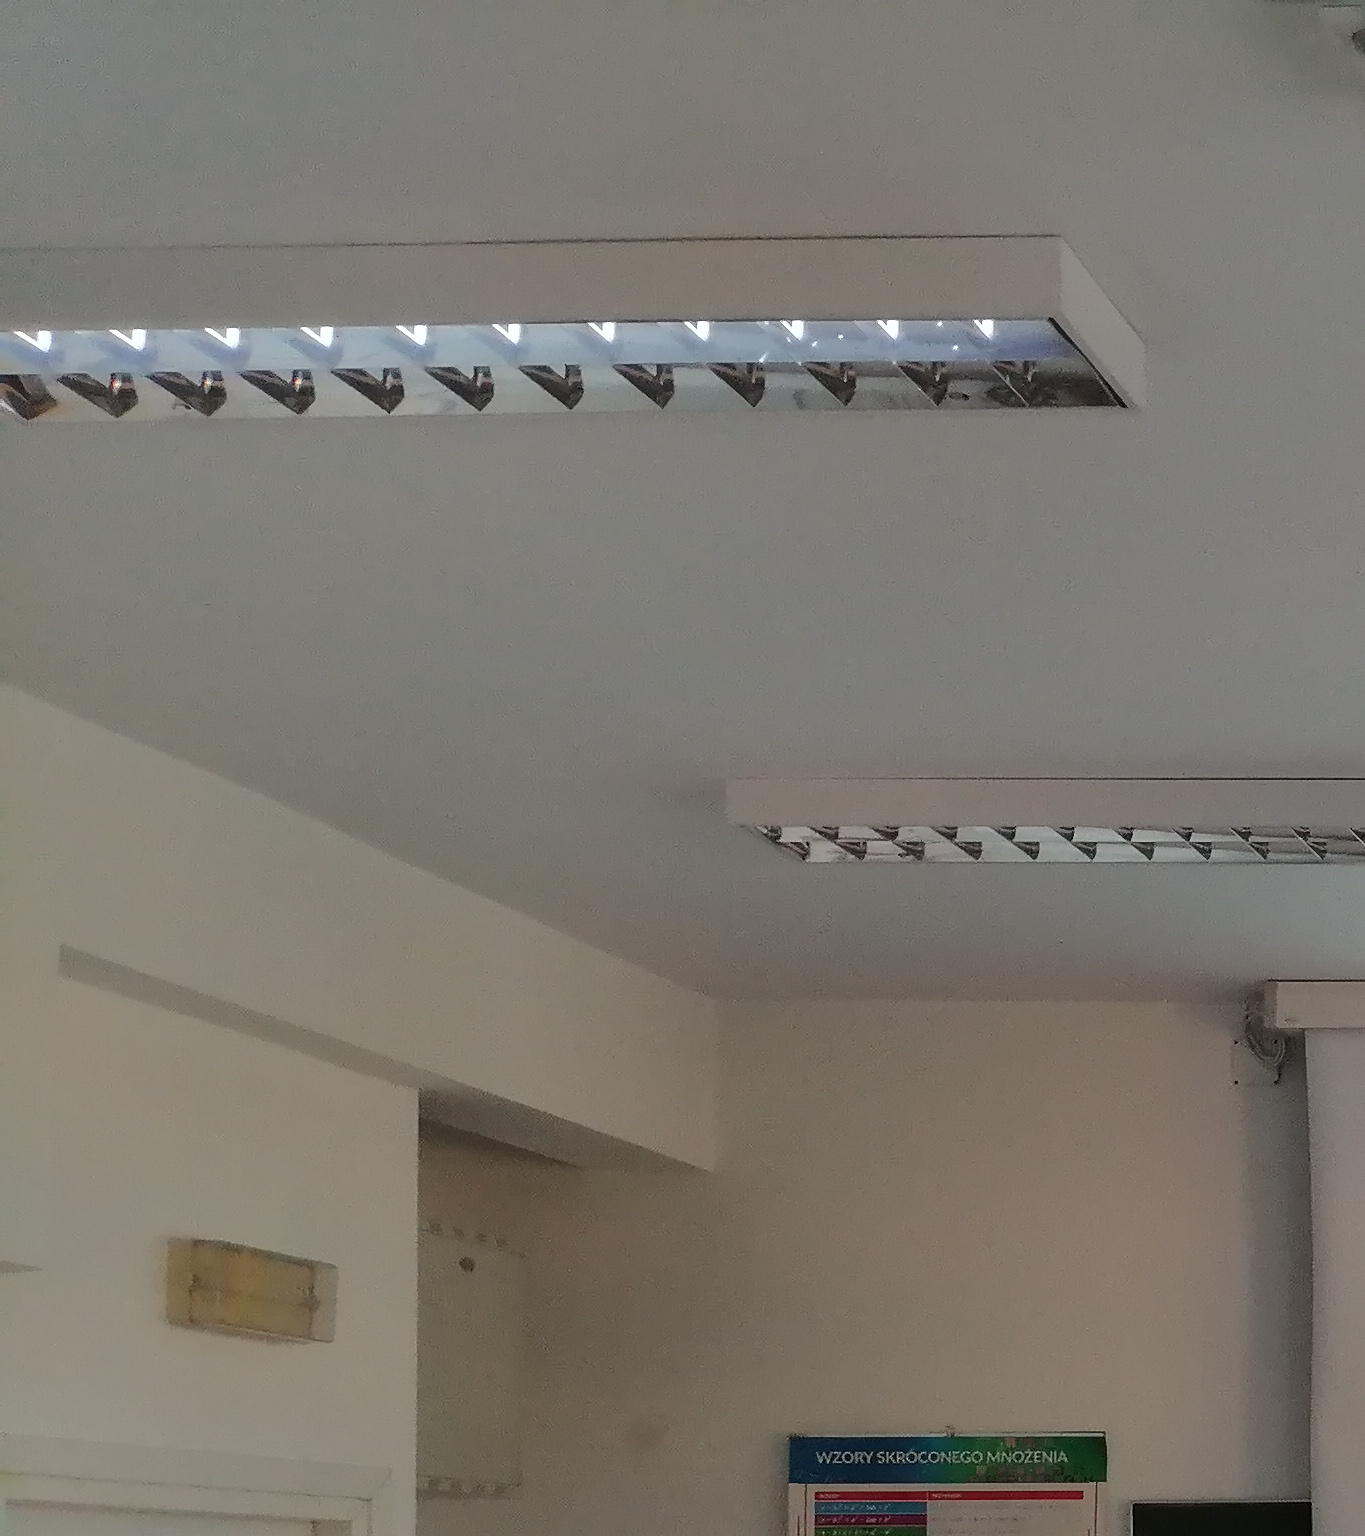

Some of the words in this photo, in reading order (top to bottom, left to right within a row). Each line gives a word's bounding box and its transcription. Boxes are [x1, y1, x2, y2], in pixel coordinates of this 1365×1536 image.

[815, 1450, 873, 1465] WZORY
[877, 1448, 983, 1464] SKRÓCONEGO
[986, 1448, 1068, 1464] MNOŻENIA
